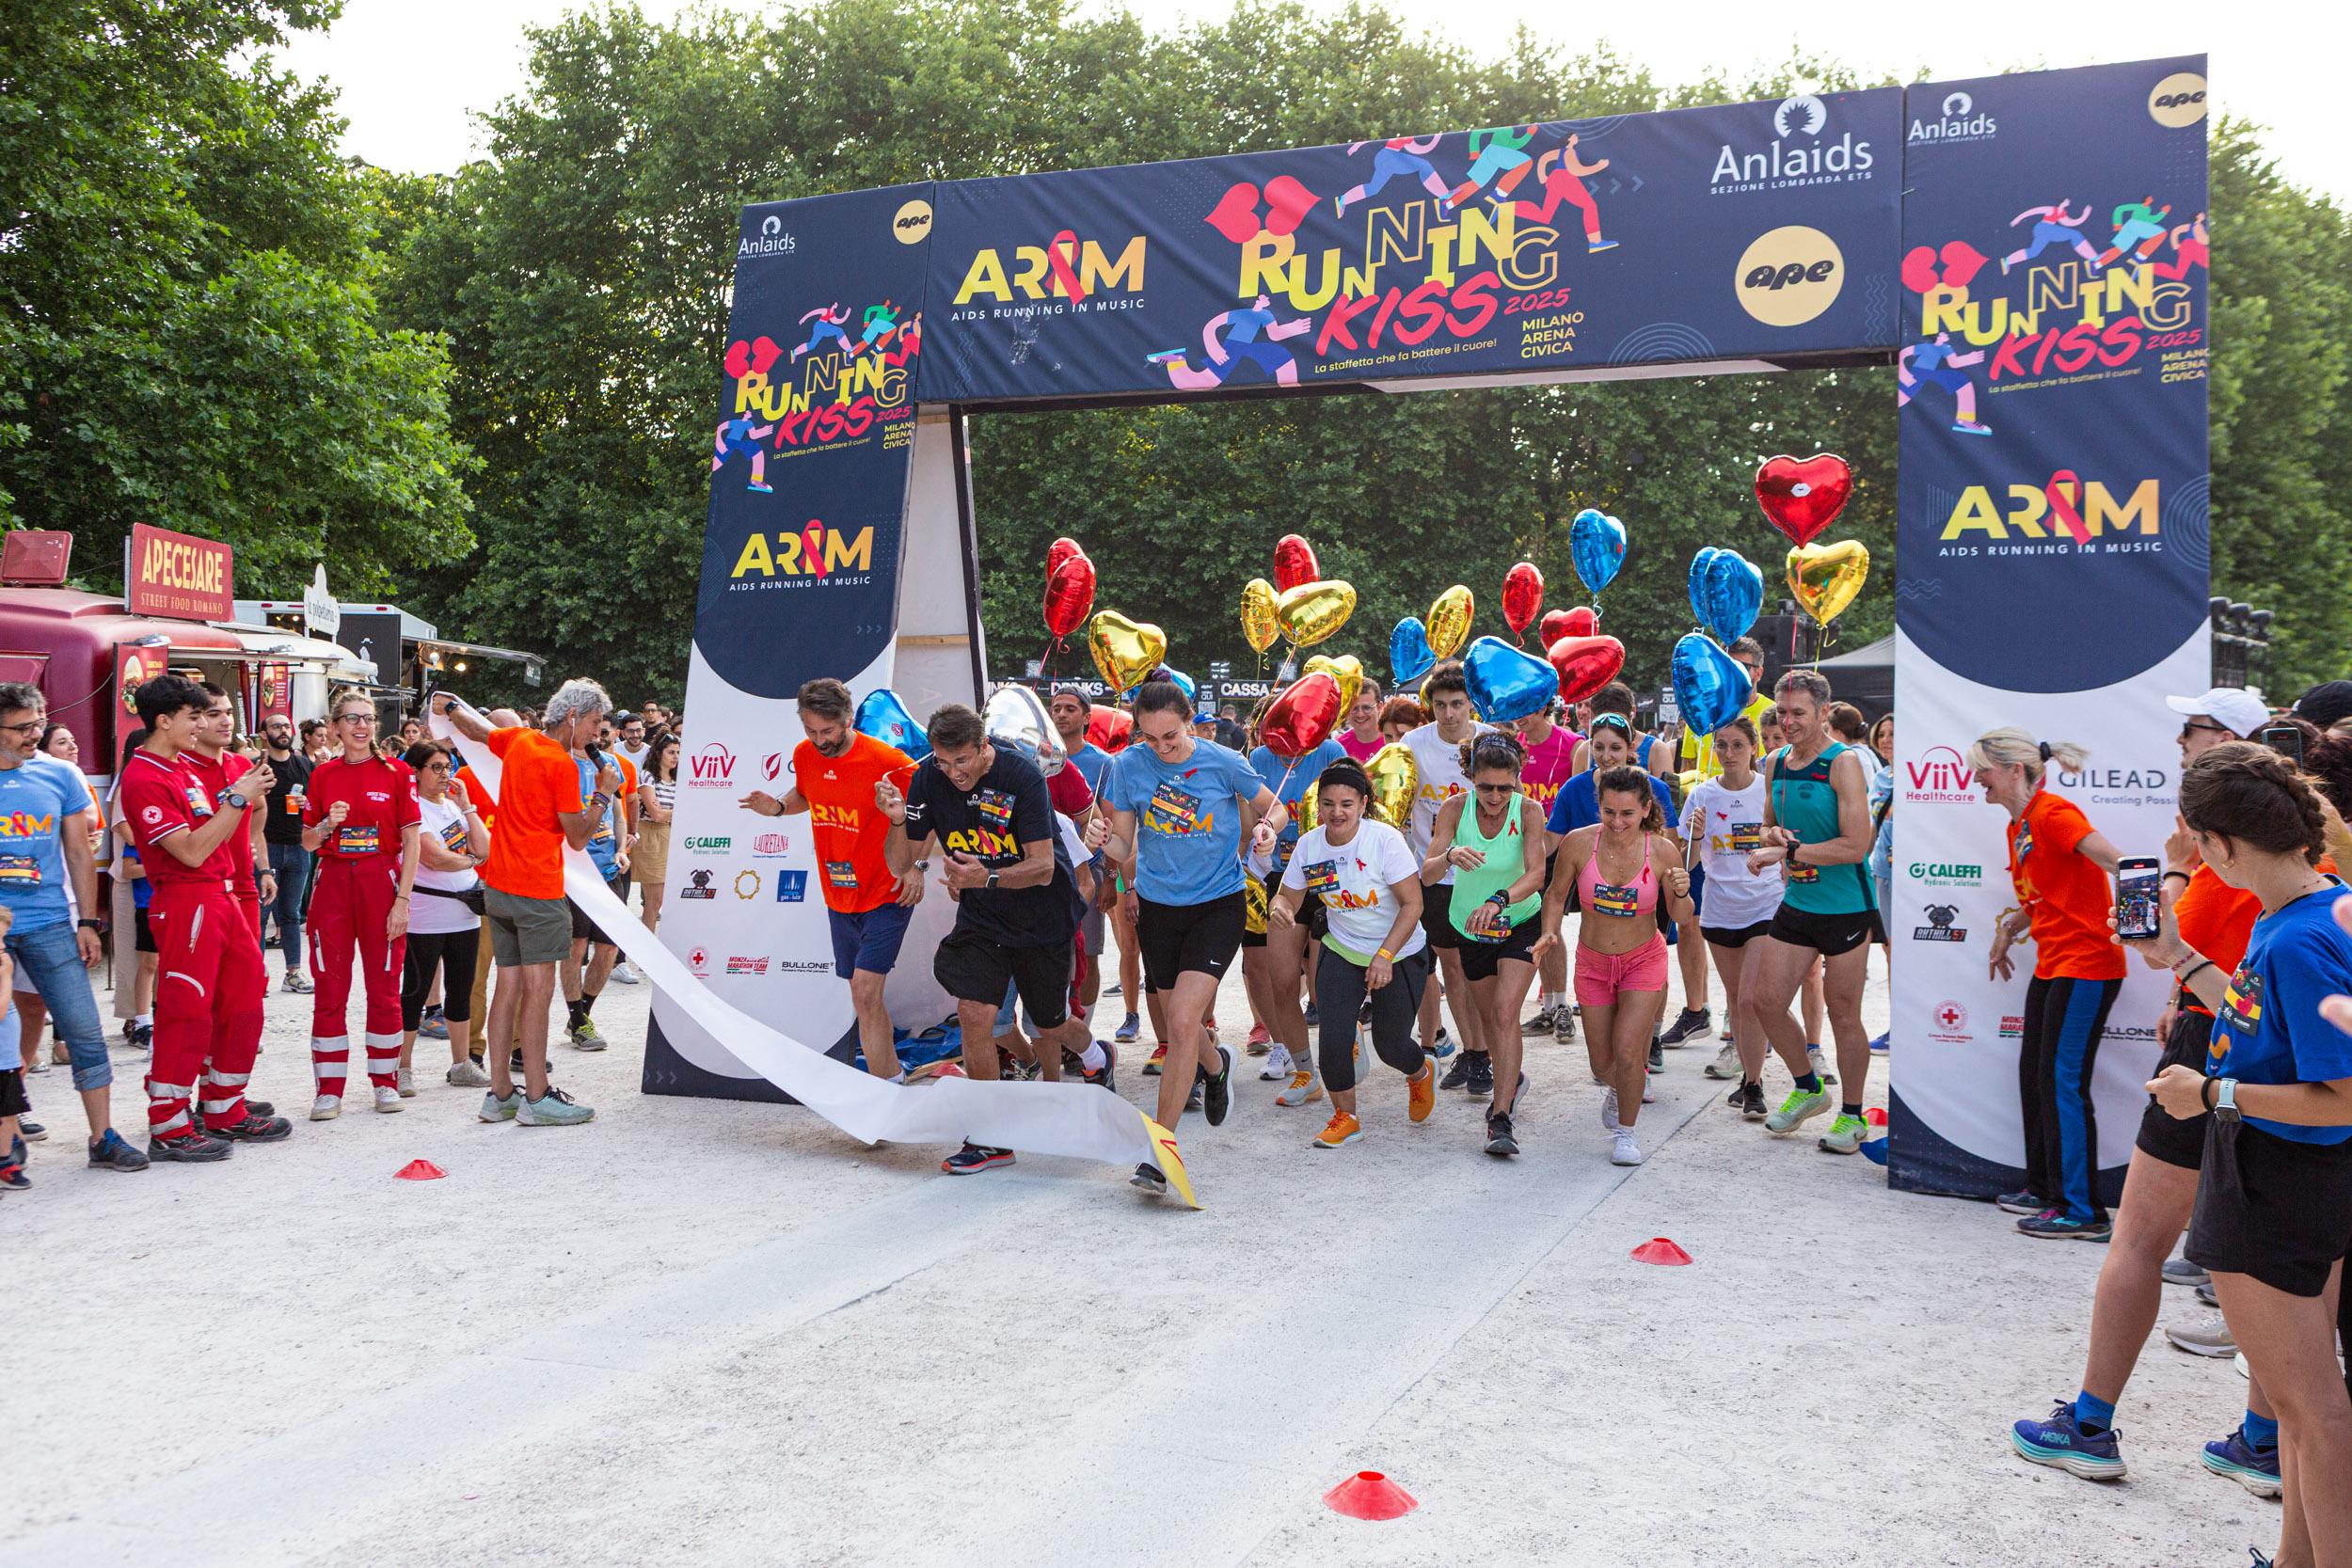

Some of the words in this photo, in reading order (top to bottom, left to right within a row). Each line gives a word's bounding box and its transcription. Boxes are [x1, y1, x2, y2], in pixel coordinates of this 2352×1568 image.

[2154, 90, 2206, 108] ape
[1908, 113, 1996, 140] Anlaids
[1710, 133, 1874, 183] Anlaids
[1710, 182, 1765, 195] SEZIONE
[1771, 175, 1841, 189] LOMBARDA
[1848, 171, 1873, 182] ETS
[896, 214, 930, 230] ape
[739, 233, 795, 255] Anlaids
[1239, 200, 1560, 311] RUNNING
[1744, 260, 1835, 291] ape
[951, 310, 986, 322] AIDS
[993, 304, 1064, 319] RUNNING
[1072, 303, 1088, 313] IN
[1097, 298, 1145, 311] MUSIC
[1922, 261, 2191, 346] RUNNING
[1315, 271, 1502, 356] KISS
[1503, 287, 1572, 315] 2025
[1522, 311, 1584, 332] MILANO
[1520, 327, 1576, 346] ARENA
[1314, 364, 1327, 373] La
[1328, 357, 1374, 372] staffetta
[1375, 354, 1396, 364] che
[1398, 352, 1409, 361] fa
[1411, 347, 1452, 359] battere
[1454, 343, 1460, 353] il
[1462, 339, 1497, 352] cuore!
[1520, 341, 1573, 358] CIVICA
[1989, 315, 2144, 380] KISS
[2146, 328, 2202, 350] 2025
[2161, 358, 2207, 372] ARENA
[735, 353, 908, 420] RUNNING
[2161, 371, 2205, 383] CIVICA
[775, 396, 876, 449] KISS
[875, 405, 912, 422] 2025
[884, 421, 915, 432] MILANO
[883, 430, 913, 441] ARENA
[883, 438, 911, 449] CIVICA
[825, 442, 847, 451] battere
[1939, 546, 1979, 557] AIDS
[1988, 544, 2069, 555] RUNNING
[2077, 544, 2096, 553] IN
[2106, 542, 2163, 553] MUSIC
[141, 536, 223, 594] APECESARE
[729, 582, 755, 591] AIDS
[760, 579, 812, 589] RUNNING
[817, 578, 829, 587] IN
[834, 576, 871, 585] MUSIC
[141, 593, 167, 608] STREET
[171, 596, 190, 610] FOOD
[194, 600, 223, 615] ROMANO
[1220, 683, 1269, 696] CASSA
[691, 756, 736, 778] ViiV
[1906, 761, 1974, 790] ViiV
[2058, 769, 2166, 788] GILEAD
[1906, 791, 1976, 801] Healthcare
[2092, 795, 2142, 806] Creating
[697, 837, 731, 847] CALEFFI
[1929, 863, 1981, 879] CALEFFI
[2040, 1431, 2071, 1446] HOKA
